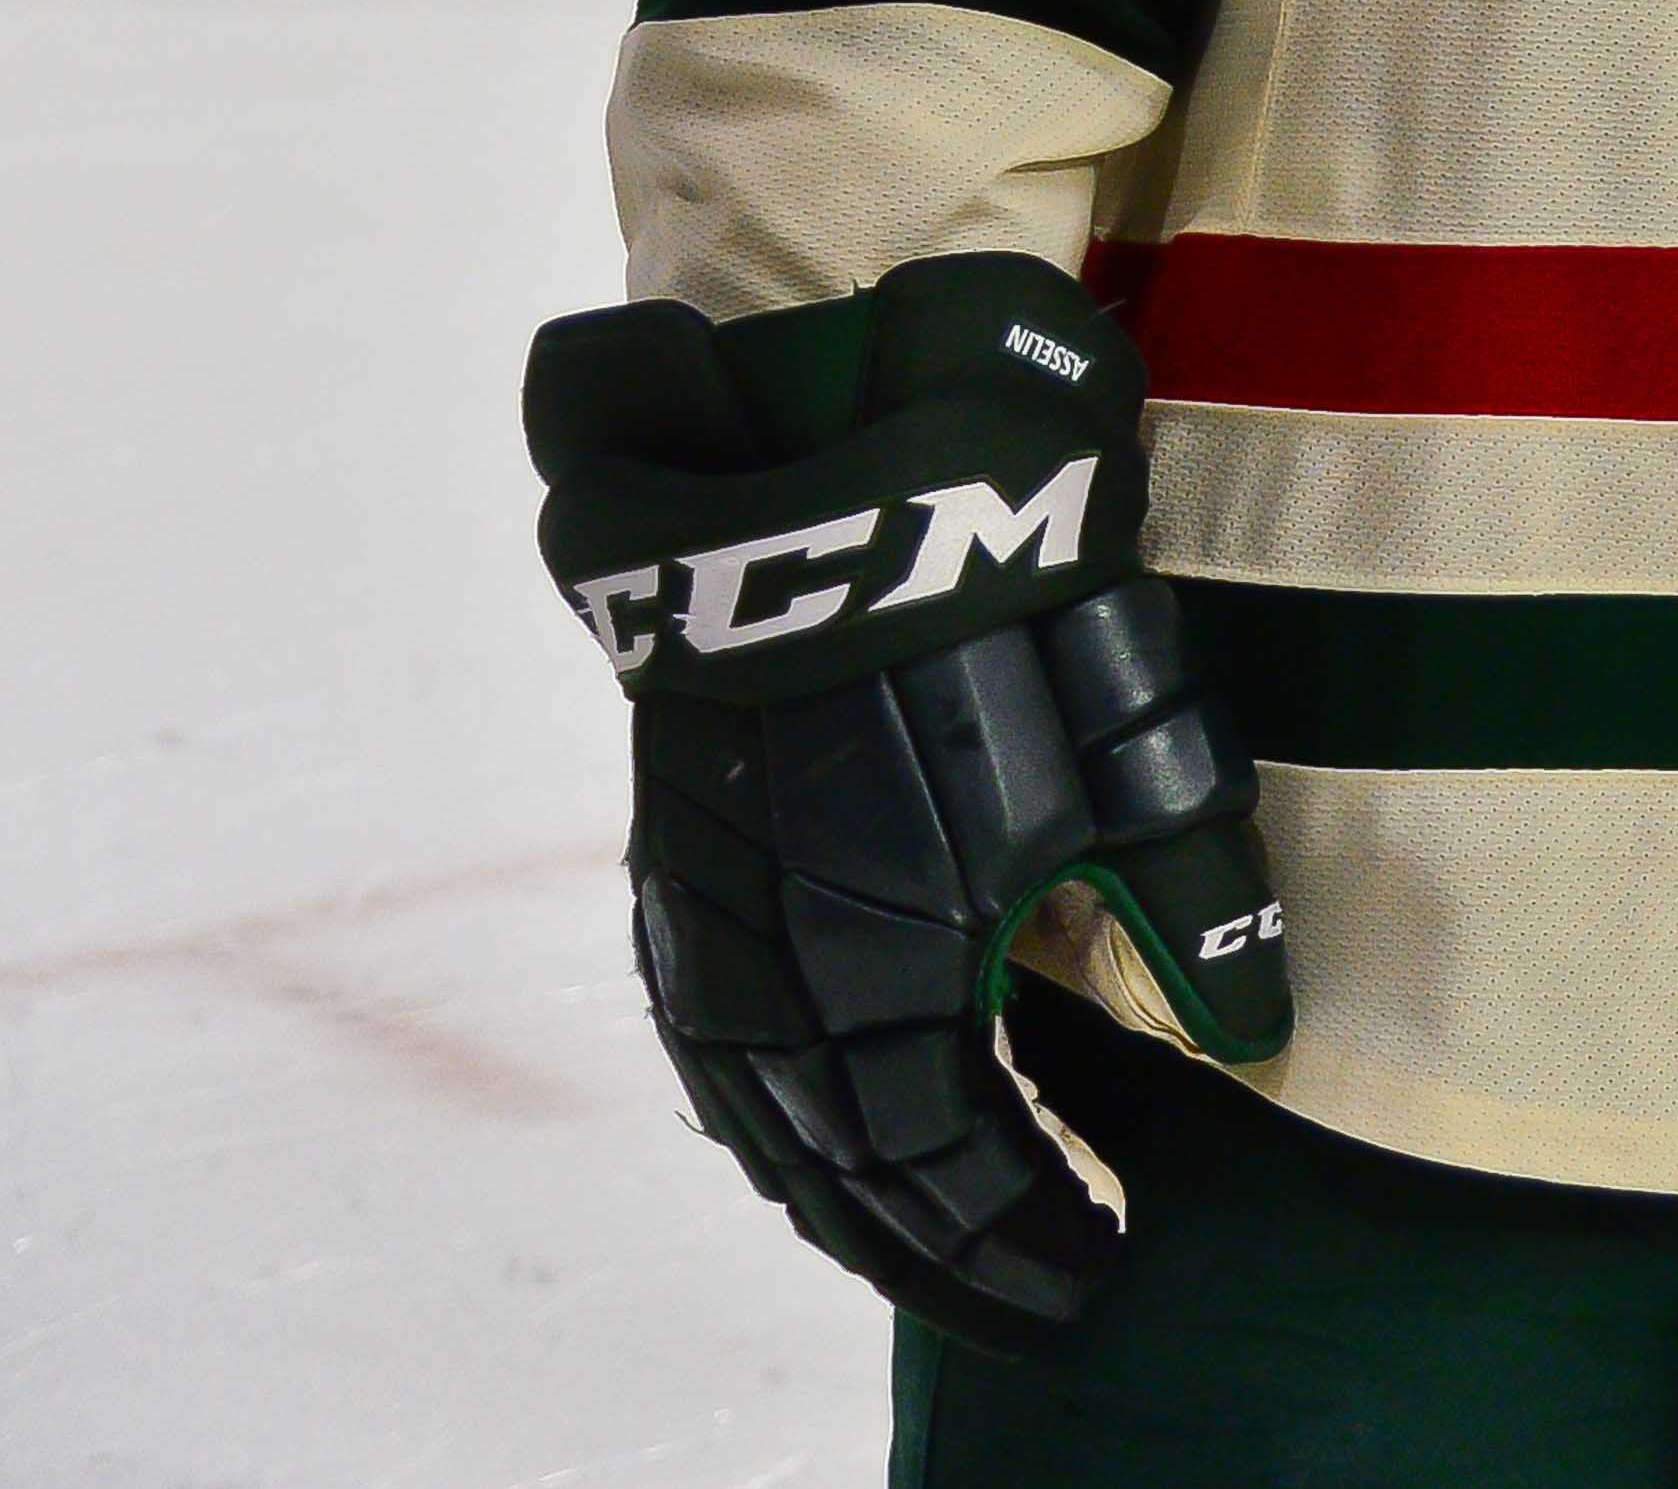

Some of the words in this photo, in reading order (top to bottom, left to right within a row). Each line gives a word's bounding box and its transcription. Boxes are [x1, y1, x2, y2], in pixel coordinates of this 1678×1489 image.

[1005, 324, 1091, 383] ASSELIN
[574, 456, 1101, 672] CCM
[1199, 900, 1283, 960] CC
